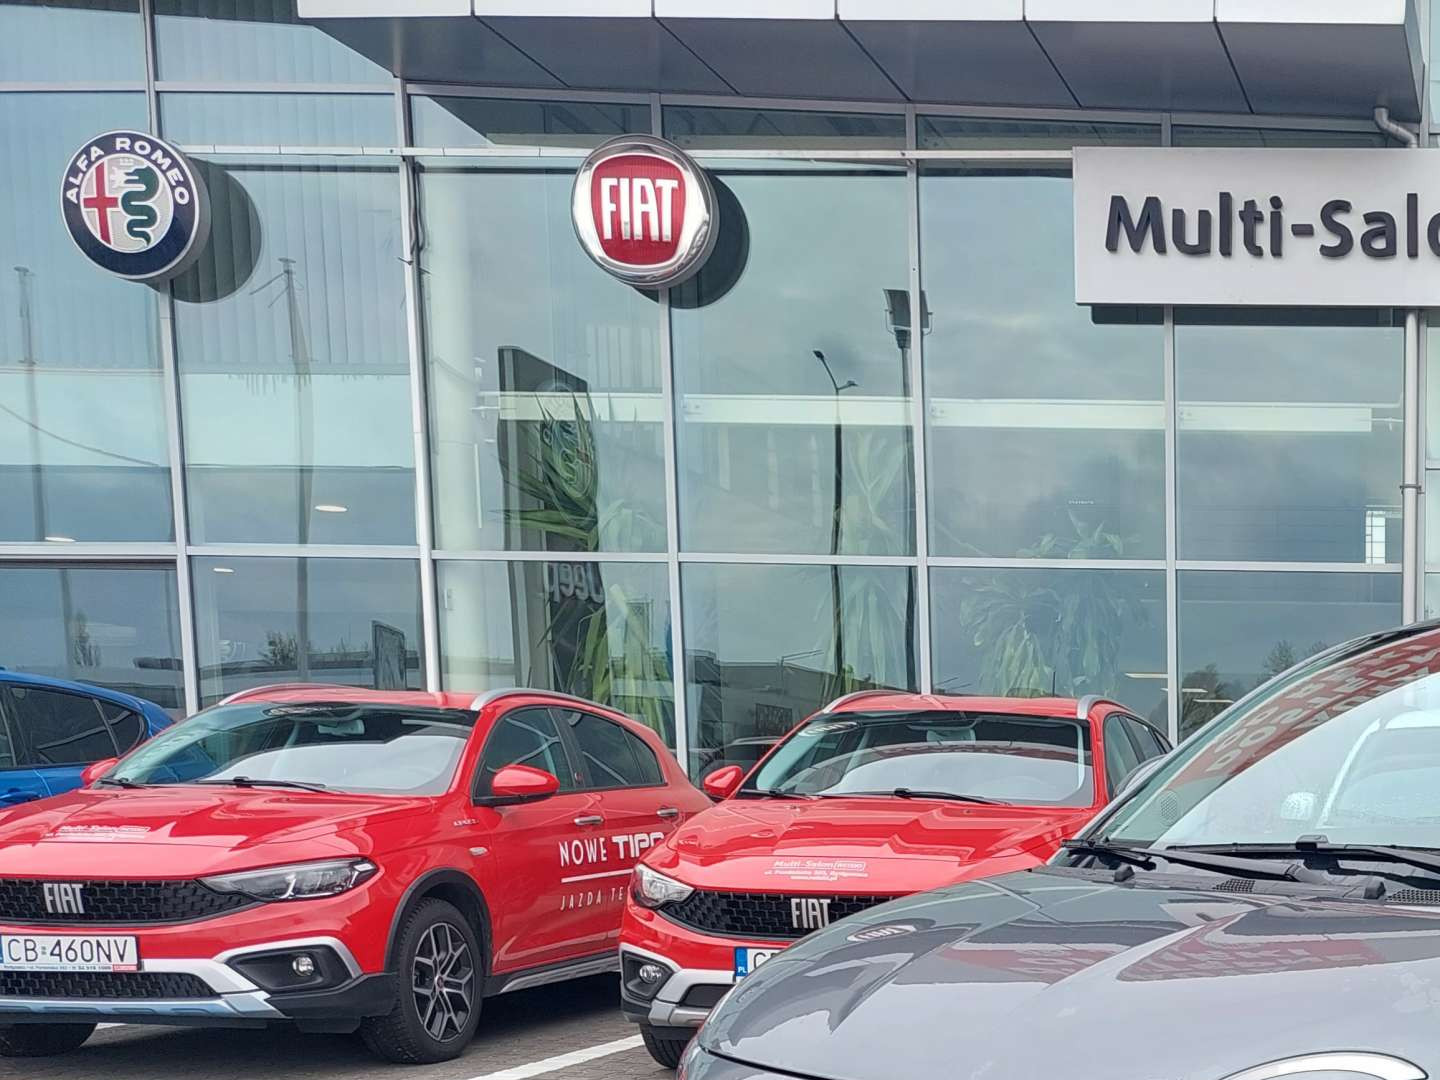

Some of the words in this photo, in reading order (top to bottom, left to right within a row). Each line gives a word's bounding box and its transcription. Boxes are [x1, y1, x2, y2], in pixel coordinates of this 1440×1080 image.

[65, 145, 105, 204] ALFA
[115, 137, 190, 205] ROMEO
[600, 177, 679, 242] FIAT
[559, 837, 607, 867] NOWE
[43, 883, 85, 914] FIAT
[560, 889, 602, 911] JAZDA
[790, 898, 831, 929] FIAT
[7, 938, 39, 962] CB
[50, 939, 128, 963] 460NV
